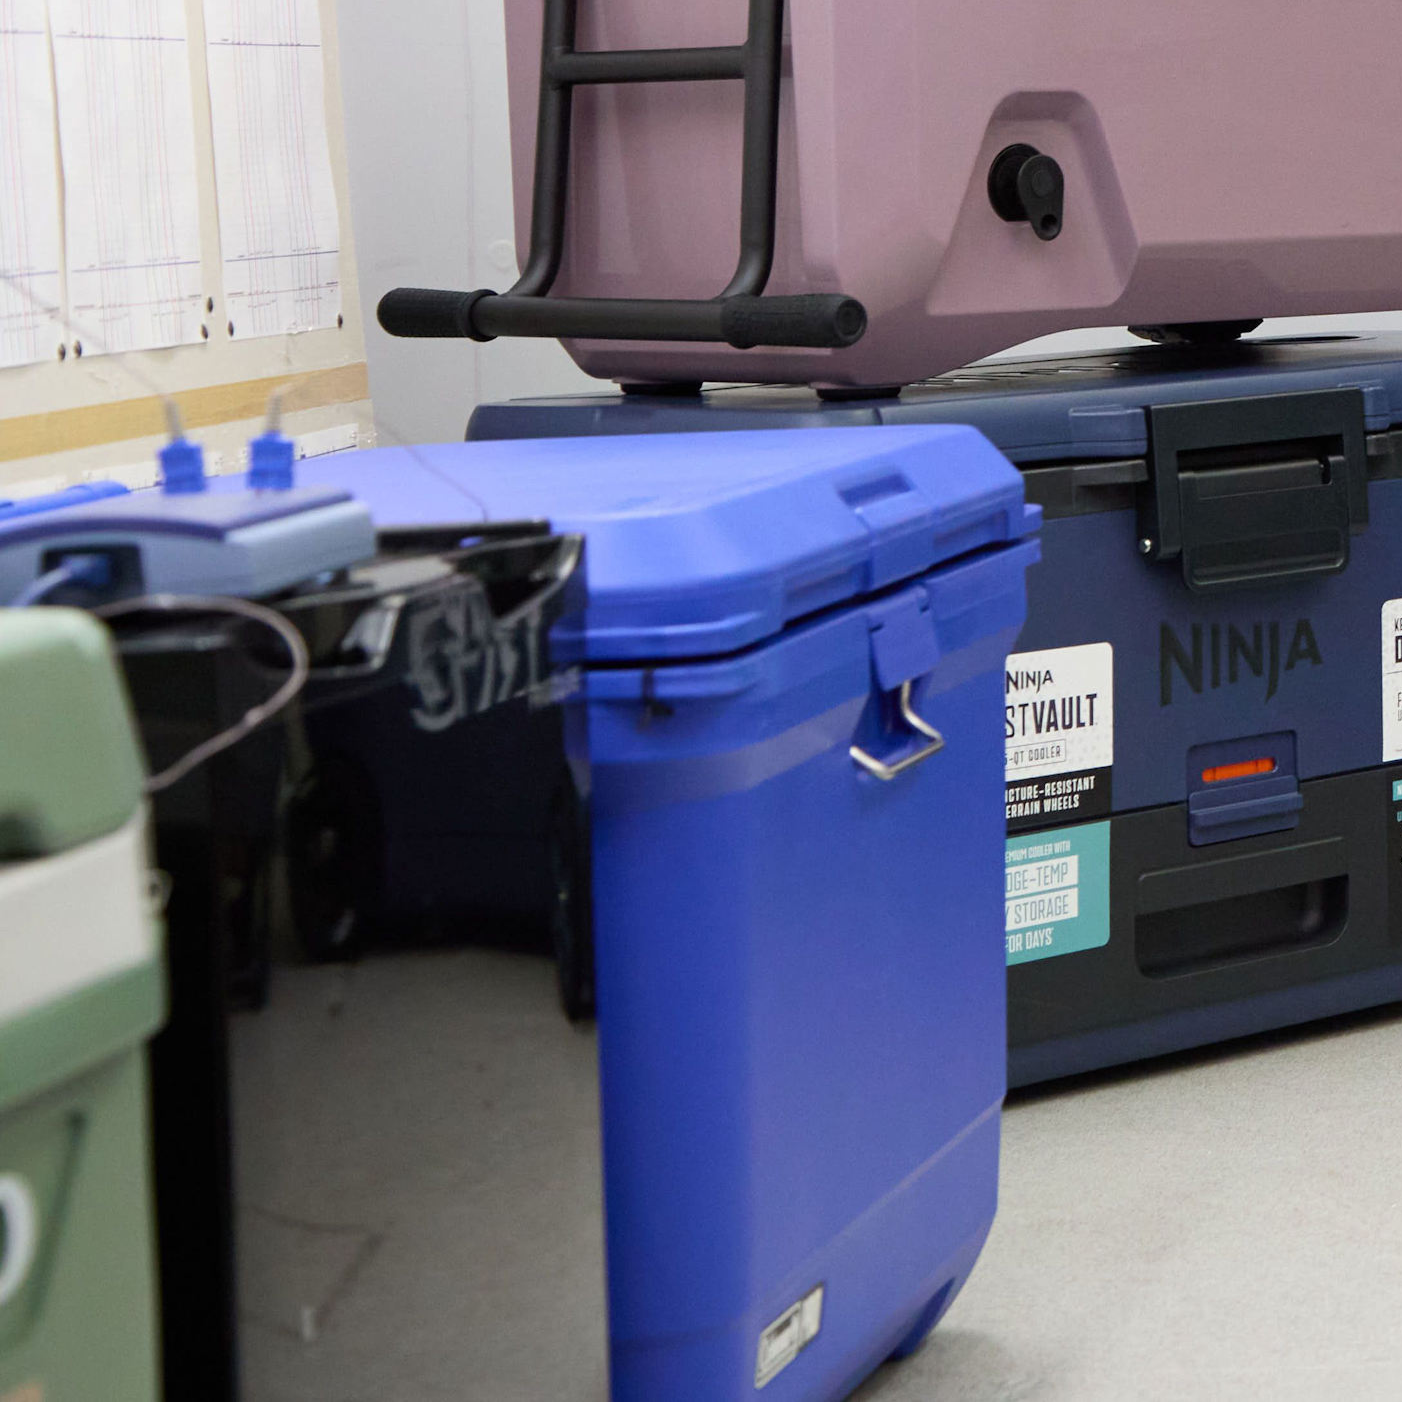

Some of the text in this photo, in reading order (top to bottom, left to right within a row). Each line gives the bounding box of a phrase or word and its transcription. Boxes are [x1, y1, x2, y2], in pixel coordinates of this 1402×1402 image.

[1159, 618, 1324, 708] NINJA
[1005, 670, 1054, 694] NINJA
[1029, 745, 1061, 762] COOLER
[1043, 794, 1080, 813] WHEELS
[1028, 843, 1053, 859] COOLER
[1054, 840, 1071, 854] WITH
[1014, 894, 1069, 924] STORAGE
